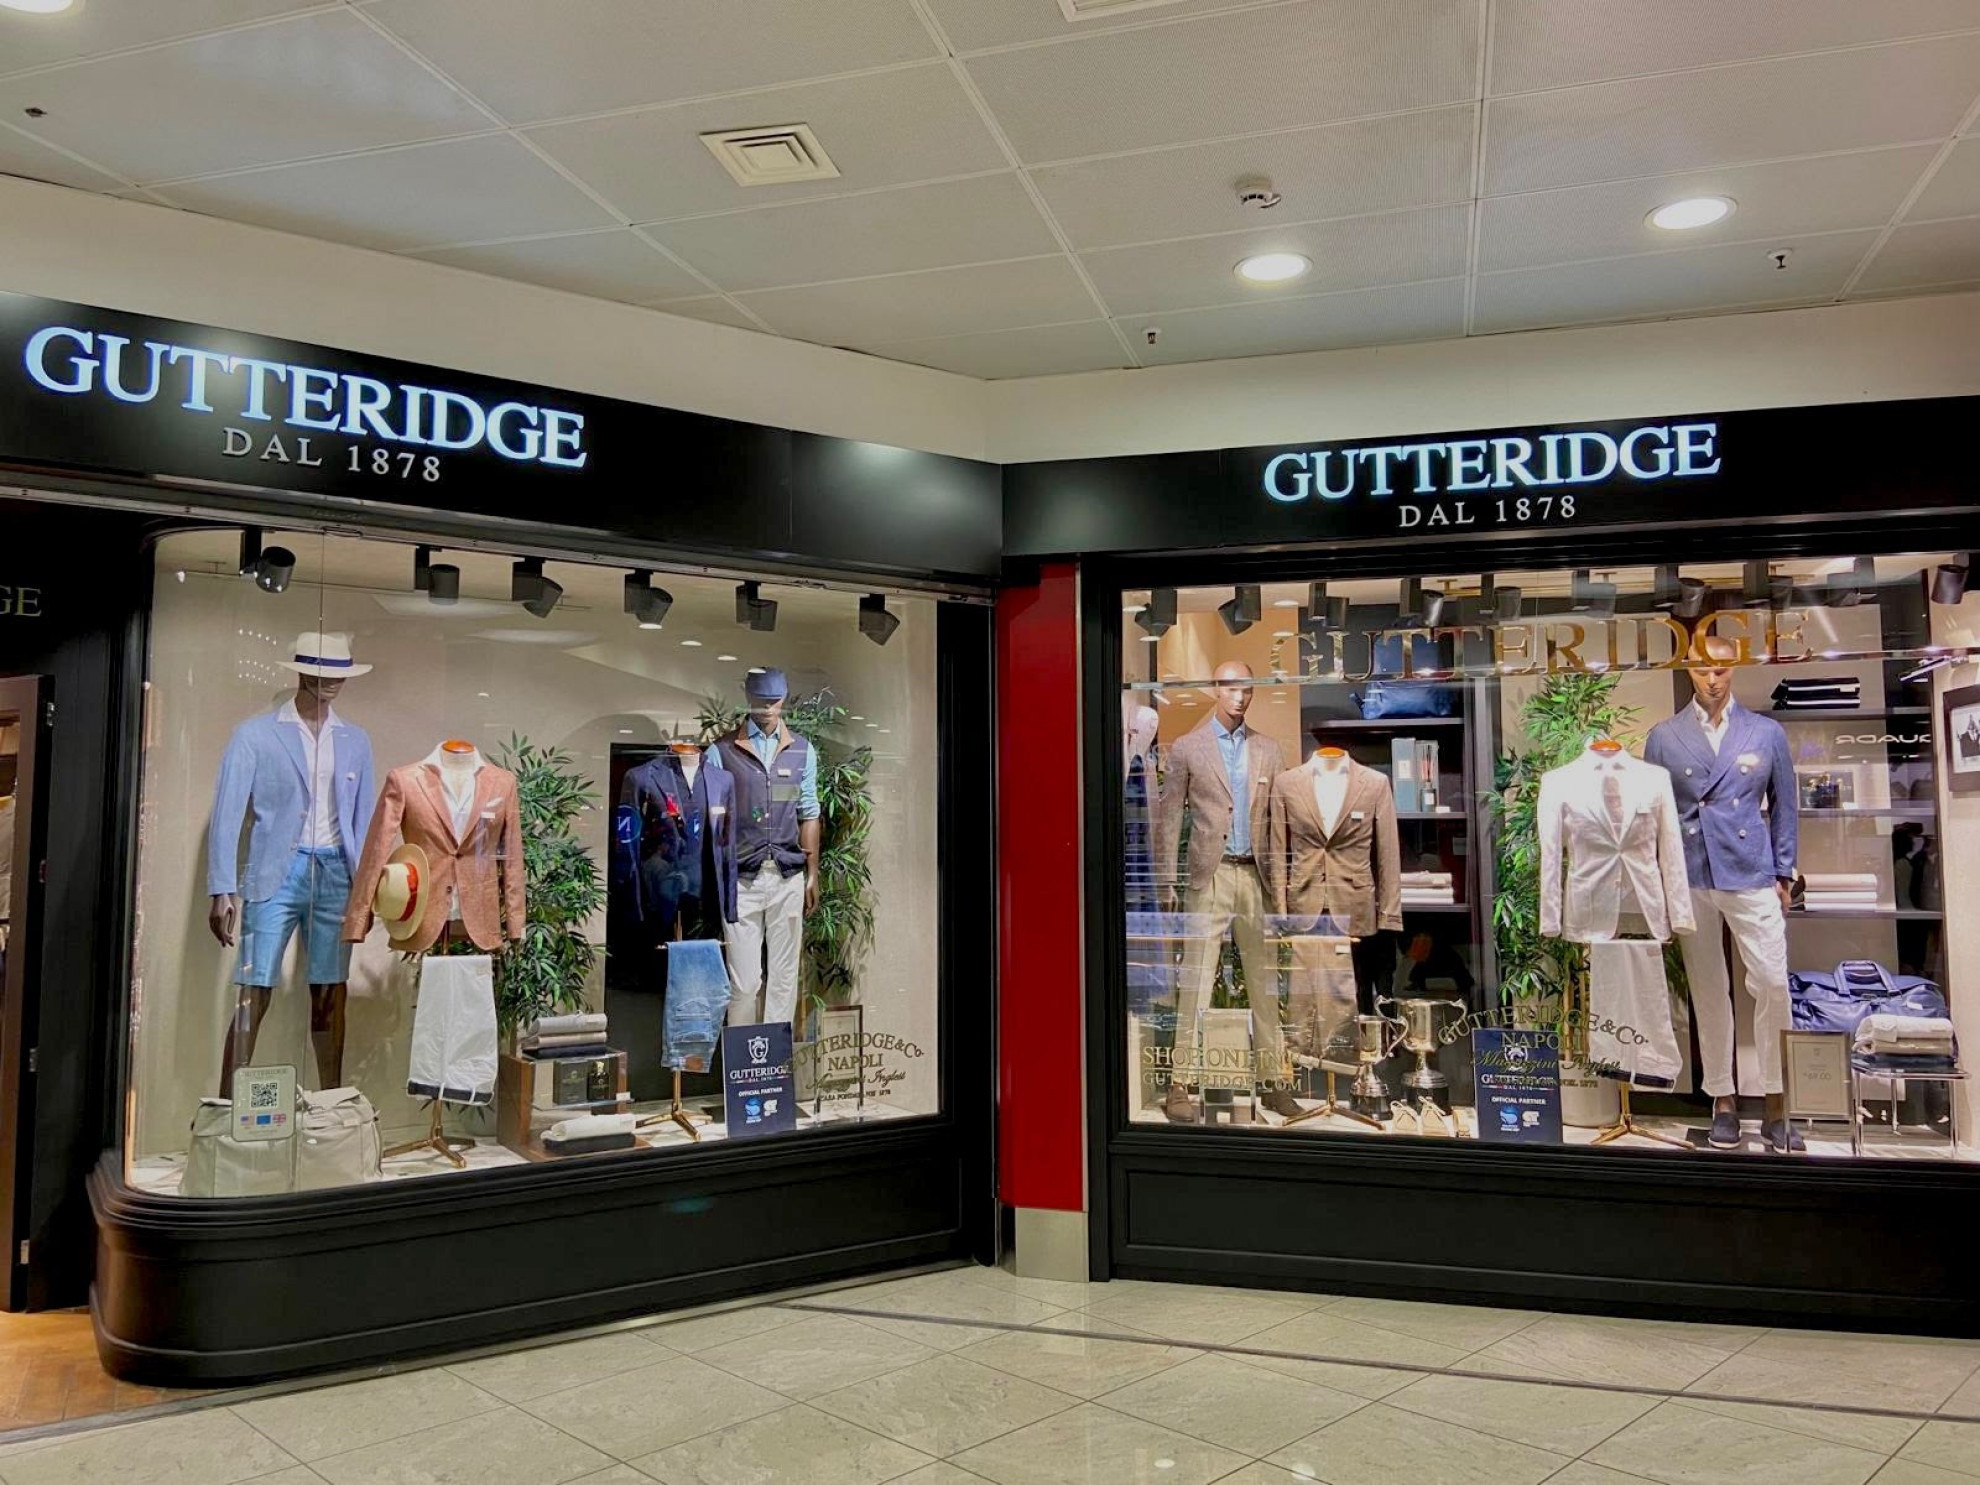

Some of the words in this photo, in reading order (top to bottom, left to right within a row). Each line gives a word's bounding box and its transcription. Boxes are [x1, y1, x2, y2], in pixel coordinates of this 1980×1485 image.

[24, 327, 588, 469] GUTTERIDGE
[223, 427, 322, 468] DAL
[348, 445, 441, 483] 1878
[1263, 422, 1721, 503] GUTTERIDGE
[1399, 501, 1475, 529] DAL
[1496, 494, 1577, 524] 1878
[1269, 610, 1813, 684] GUTTERIDGE
[828, 1053, 883, 1072] NAPOLI
[1143, 1046, 1200, 1066] SHOP
